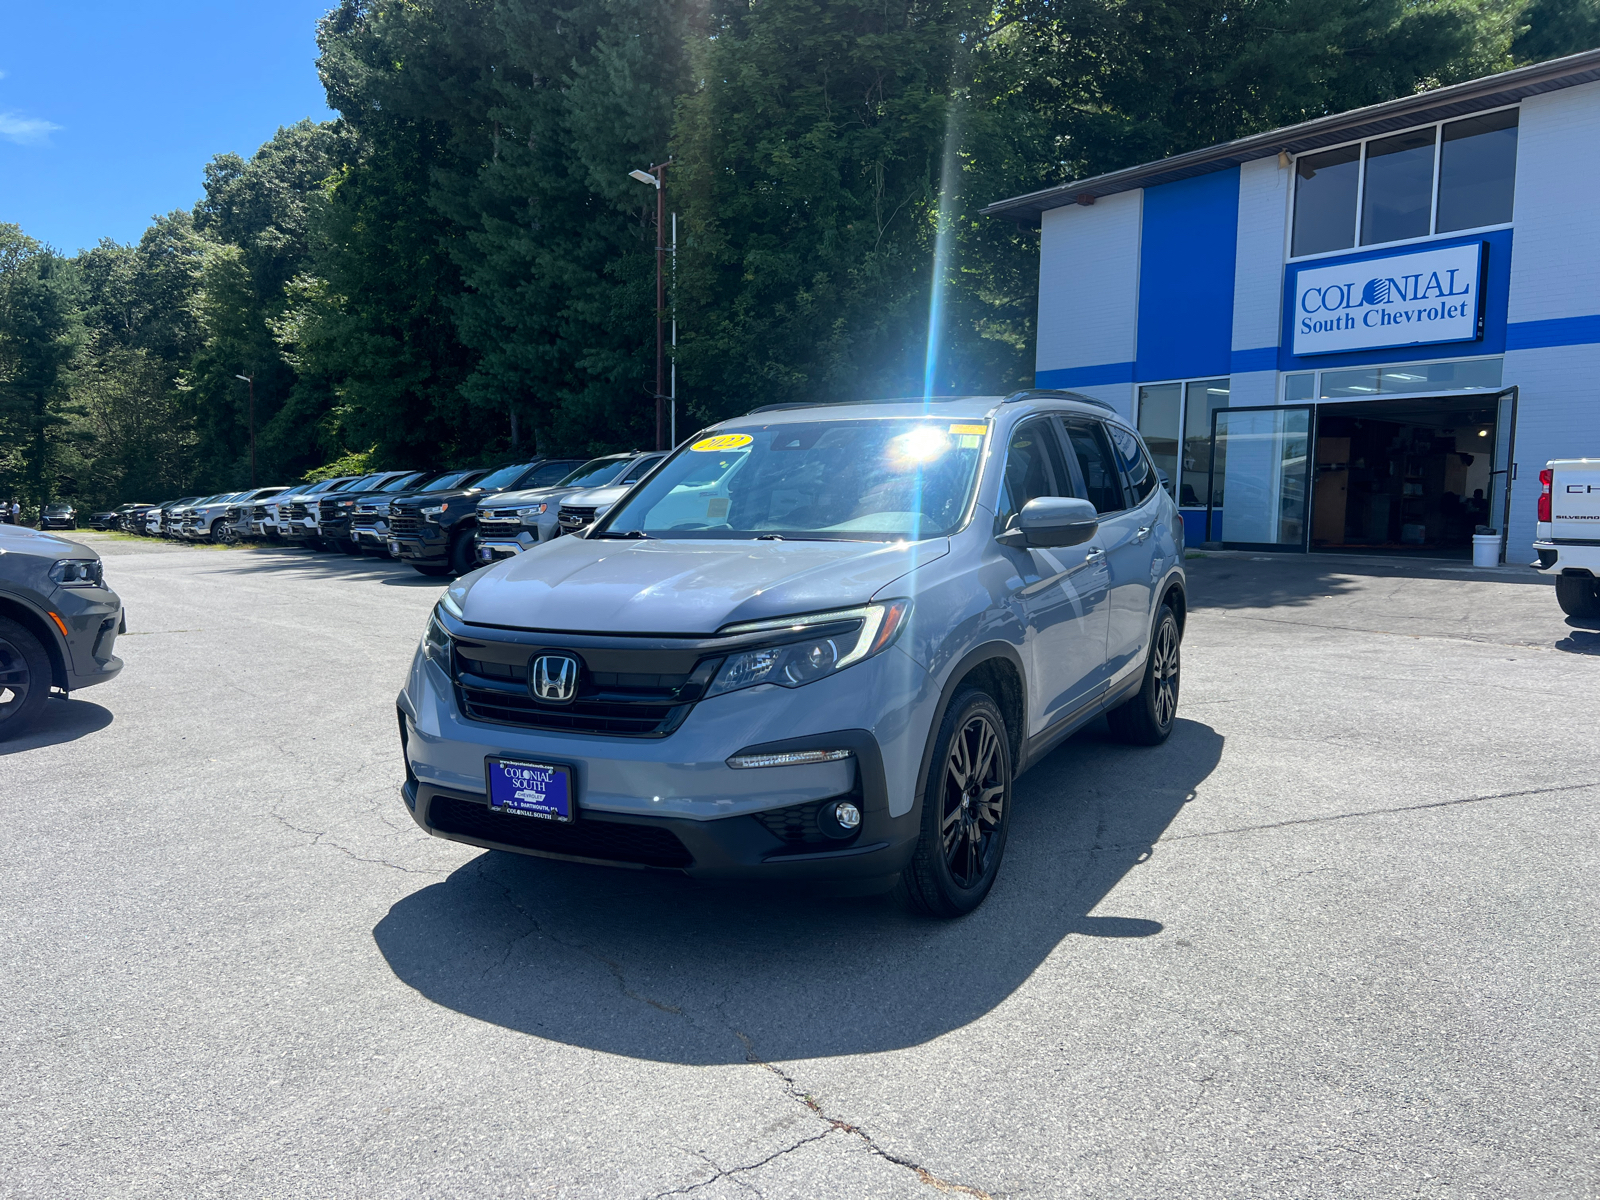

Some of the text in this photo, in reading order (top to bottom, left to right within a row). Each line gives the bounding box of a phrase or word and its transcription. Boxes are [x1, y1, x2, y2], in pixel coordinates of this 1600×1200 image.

[1301, 269, 1470, 314] COLONIAL
[1301, 300, 1468, 334] South Chevrolet
[697, 436, 745, 449] 2022
[499, 760, 554, 770] www.buycolonialsouth.com
[504, 767, 553, 783] COLONIAL
[512, 778, 546, 791] SOUTH
[517, 792, 543, 800] CHEVROLET
[506, 808, 552, 820] COLONIAL SOUTH
